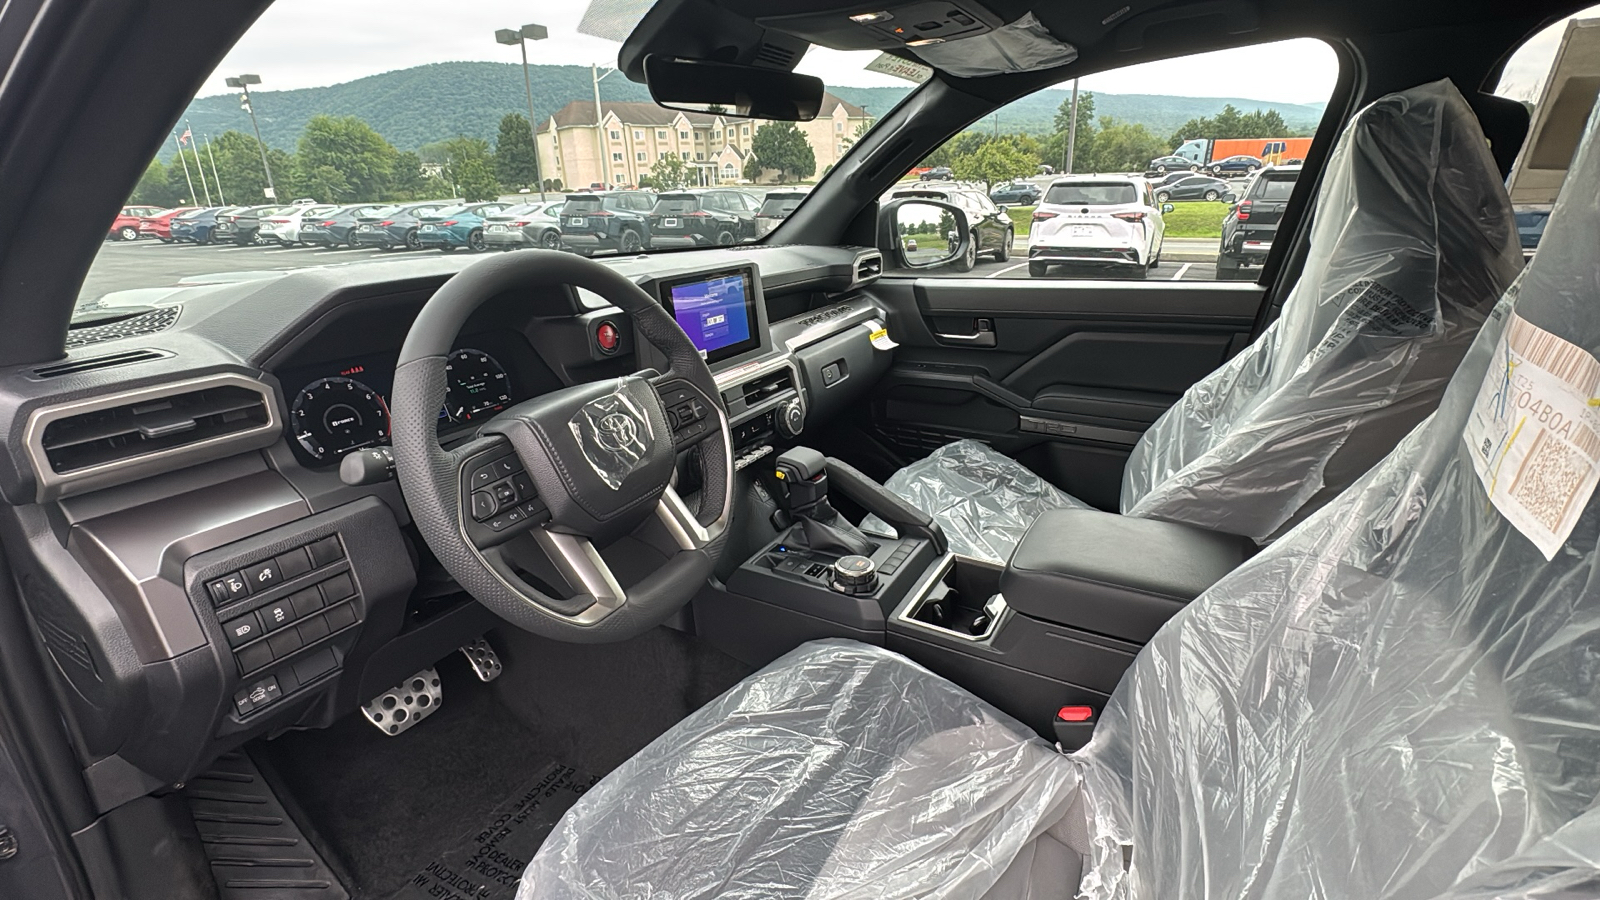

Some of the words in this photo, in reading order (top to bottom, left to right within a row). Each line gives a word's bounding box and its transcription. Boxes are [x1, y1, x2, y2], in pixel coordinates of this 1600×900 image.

[238, 697, 248, 705] OFF
[514, 764, 567, 811] PROTECTIVE
[474, 813, 512, 844] COVER
[488, 850, 525, 872] DEALER
